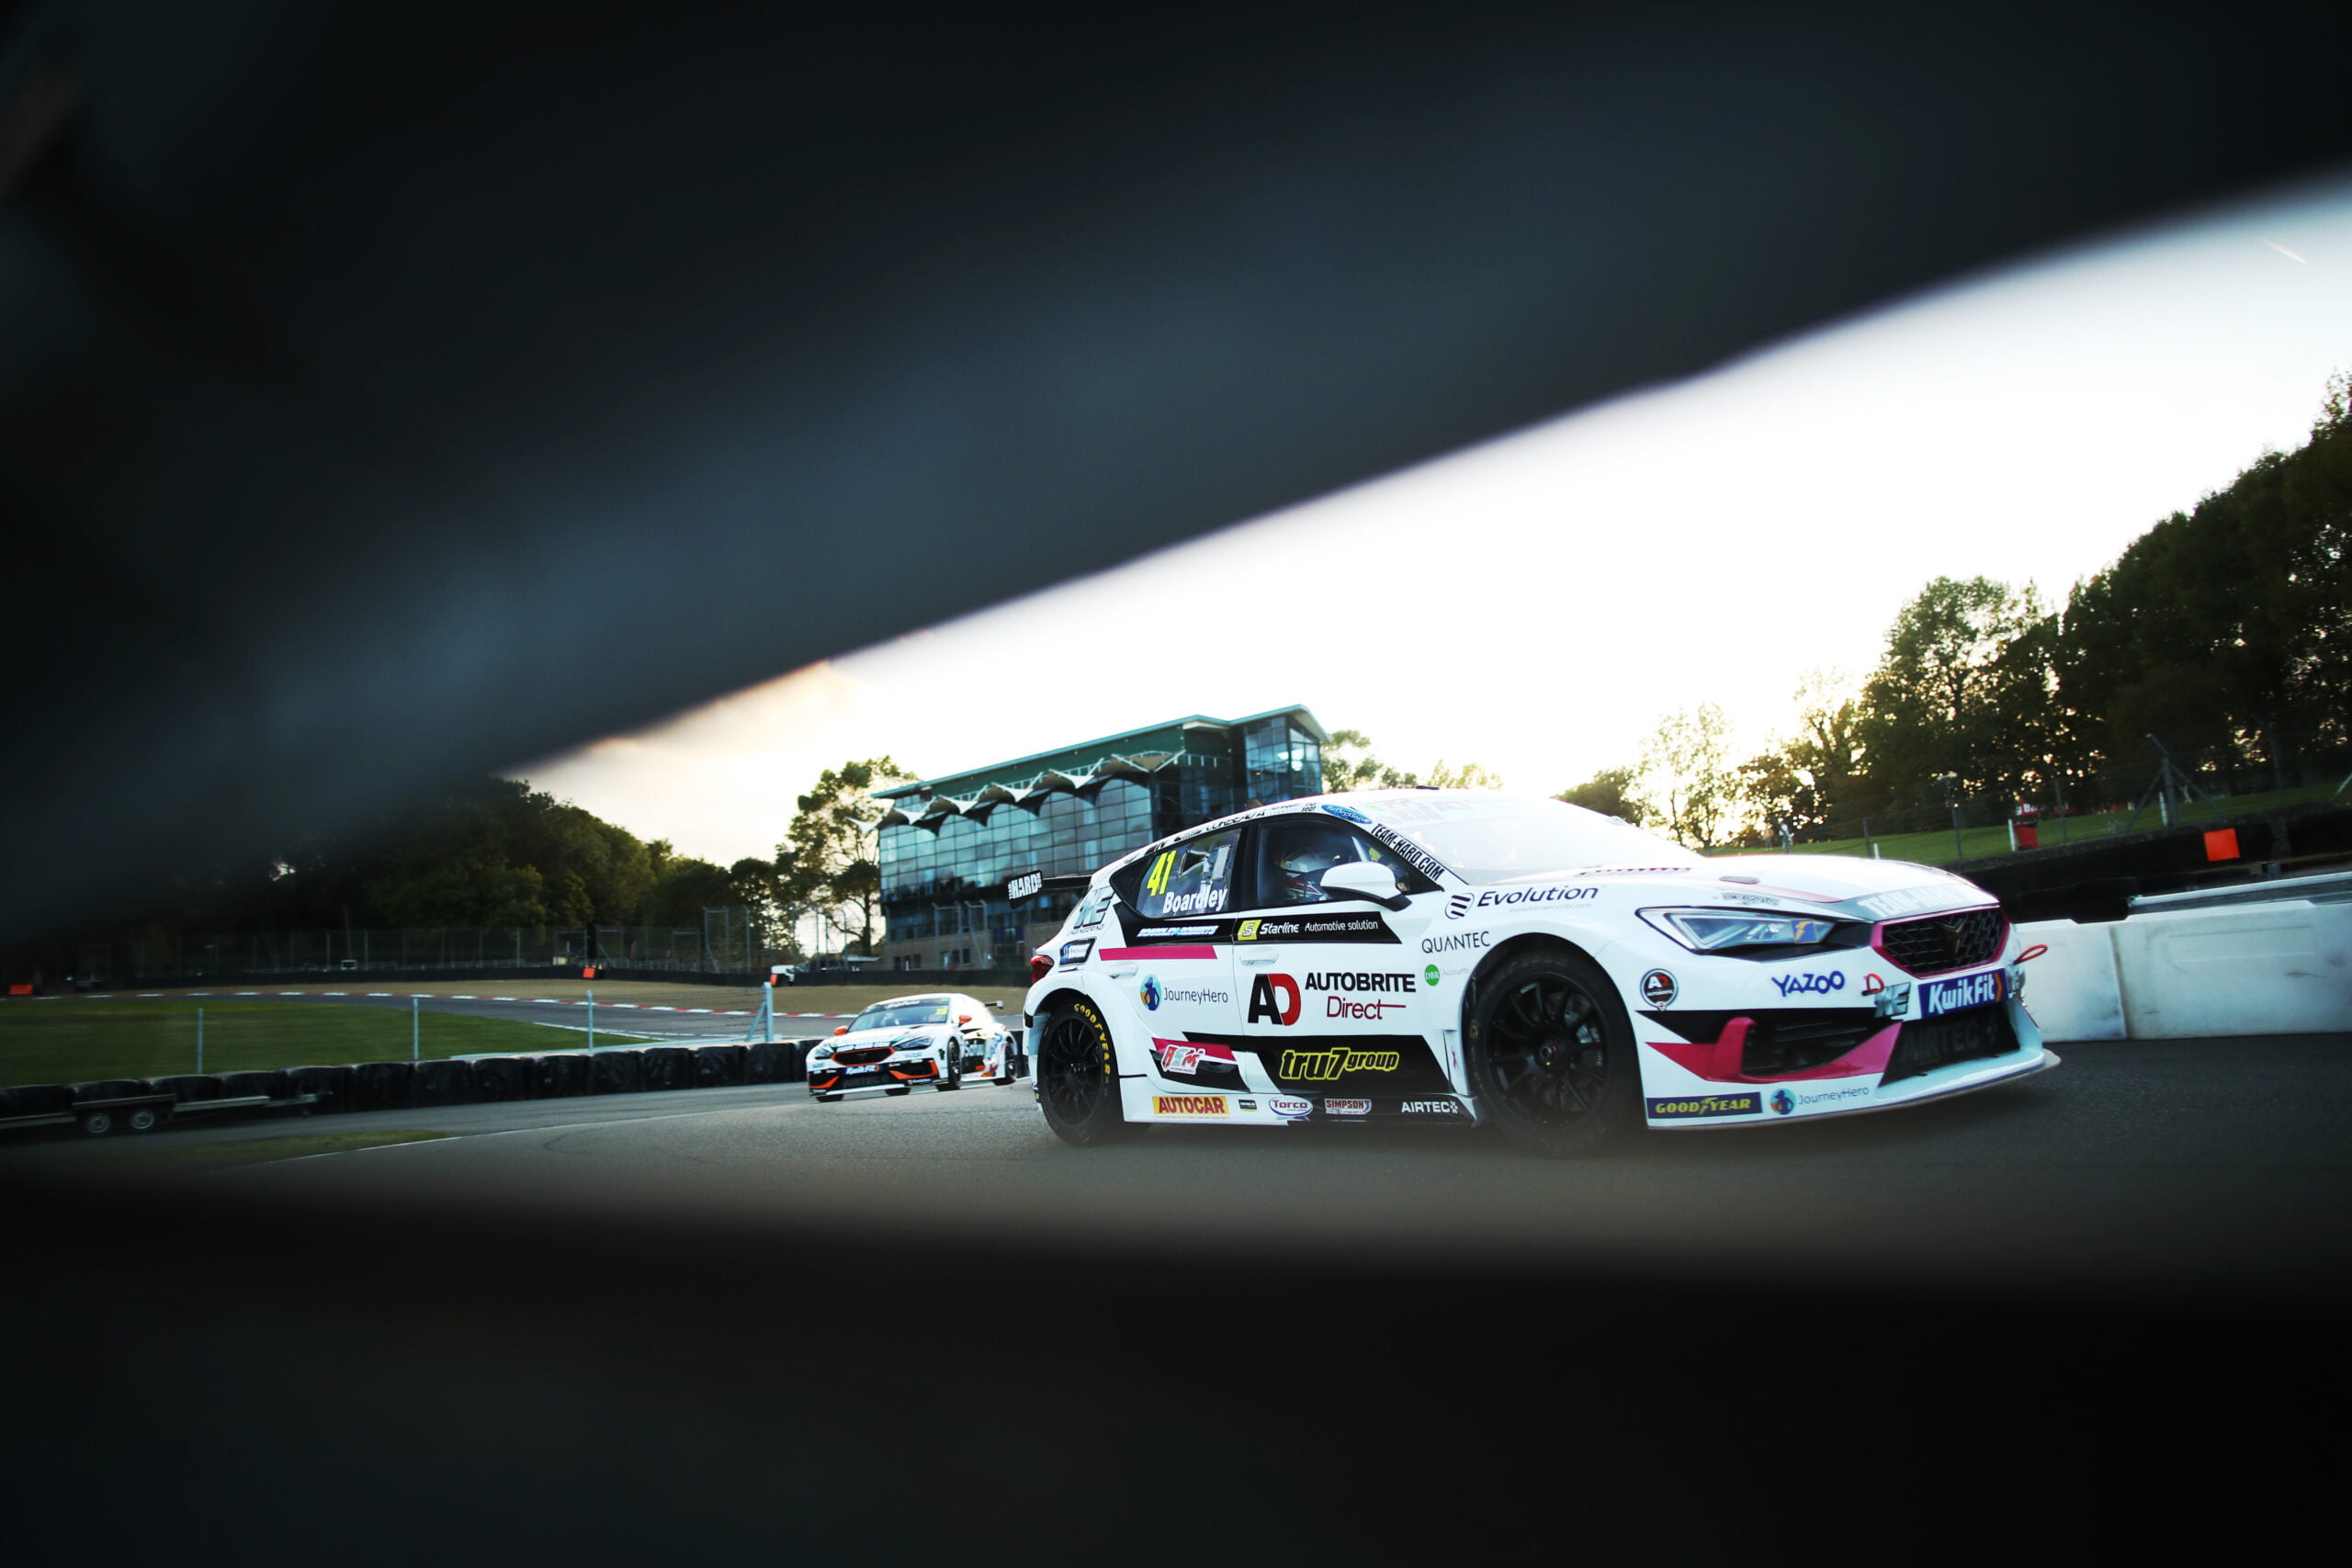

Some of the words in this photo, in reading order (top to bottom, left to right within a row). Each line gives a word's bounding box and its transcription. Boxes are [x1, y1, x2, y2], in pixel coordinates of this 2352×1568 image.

[1147, 851, 1177, 897] 41
[1012, 874, 1039, 899] HARD
[1162, 887, 1228, 914] Boardley
[1476, 885, 1600, 908] Evolution
[1260, 922, 1299, 935] Starline
[1305, 921, 1346, 932] Automotive
[1348, 919, 1379, 931] solution
[1421, 931, 1490, 953] QUANTEC
[1305, 972, 1416, 993] AUTOBRITE
[1425, 970, 1441, 980] DBR
[1770, 970, 1846, 998] YAZOO
[1163, 987, 1228, 1005] JourneyHero
[1248, 973, 1301, 1026] AD
[1327, 996, 1407, 1020] Direct
[1159, 1096, 1226, 1113] AUTOCAR
[1272, 1100, 1308, 1109] Torco
[1326, 1100, 1364, 1109] SIMPSON
[1798, 1087, 1870, 1105] JourneyHero
[1401, 1101, 1450, 1113] AIRTEC
[1655, 1098, 1752, 1115] GOODYEAR
